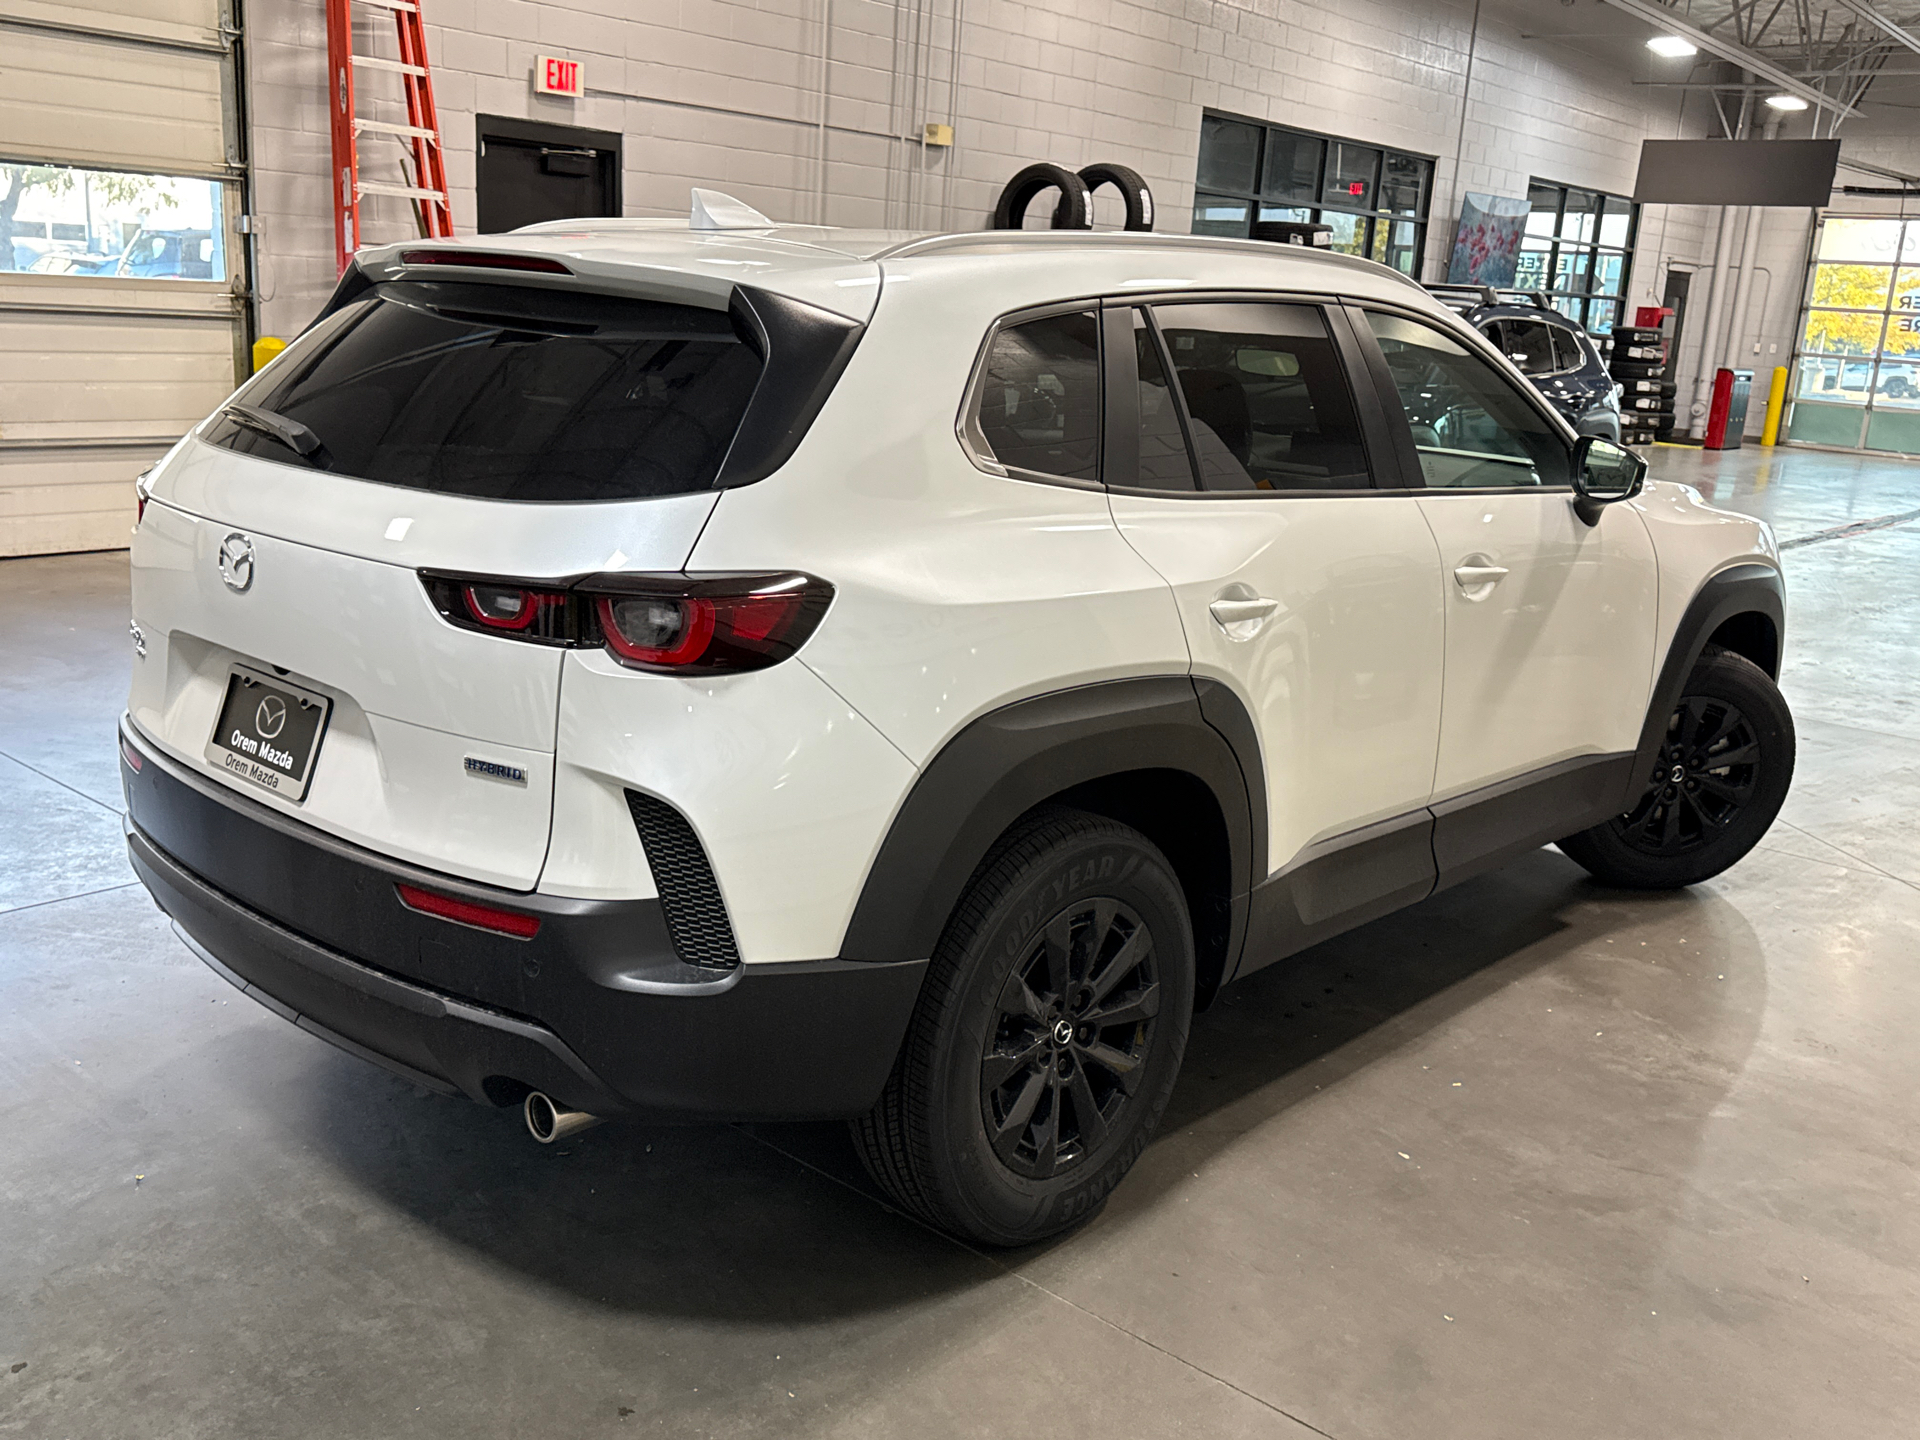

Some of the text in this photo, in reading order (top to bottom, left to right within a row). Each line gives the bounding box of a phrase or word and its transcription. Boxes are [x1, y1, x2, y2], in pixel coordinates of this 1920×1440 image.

[546, 58, 578, 94] EXIT
[231, 729, 294, 770] Orem Mazda
[225, 753, 279, 789] Orem Mazda
[468, 758, 522, 780] HYBRID
